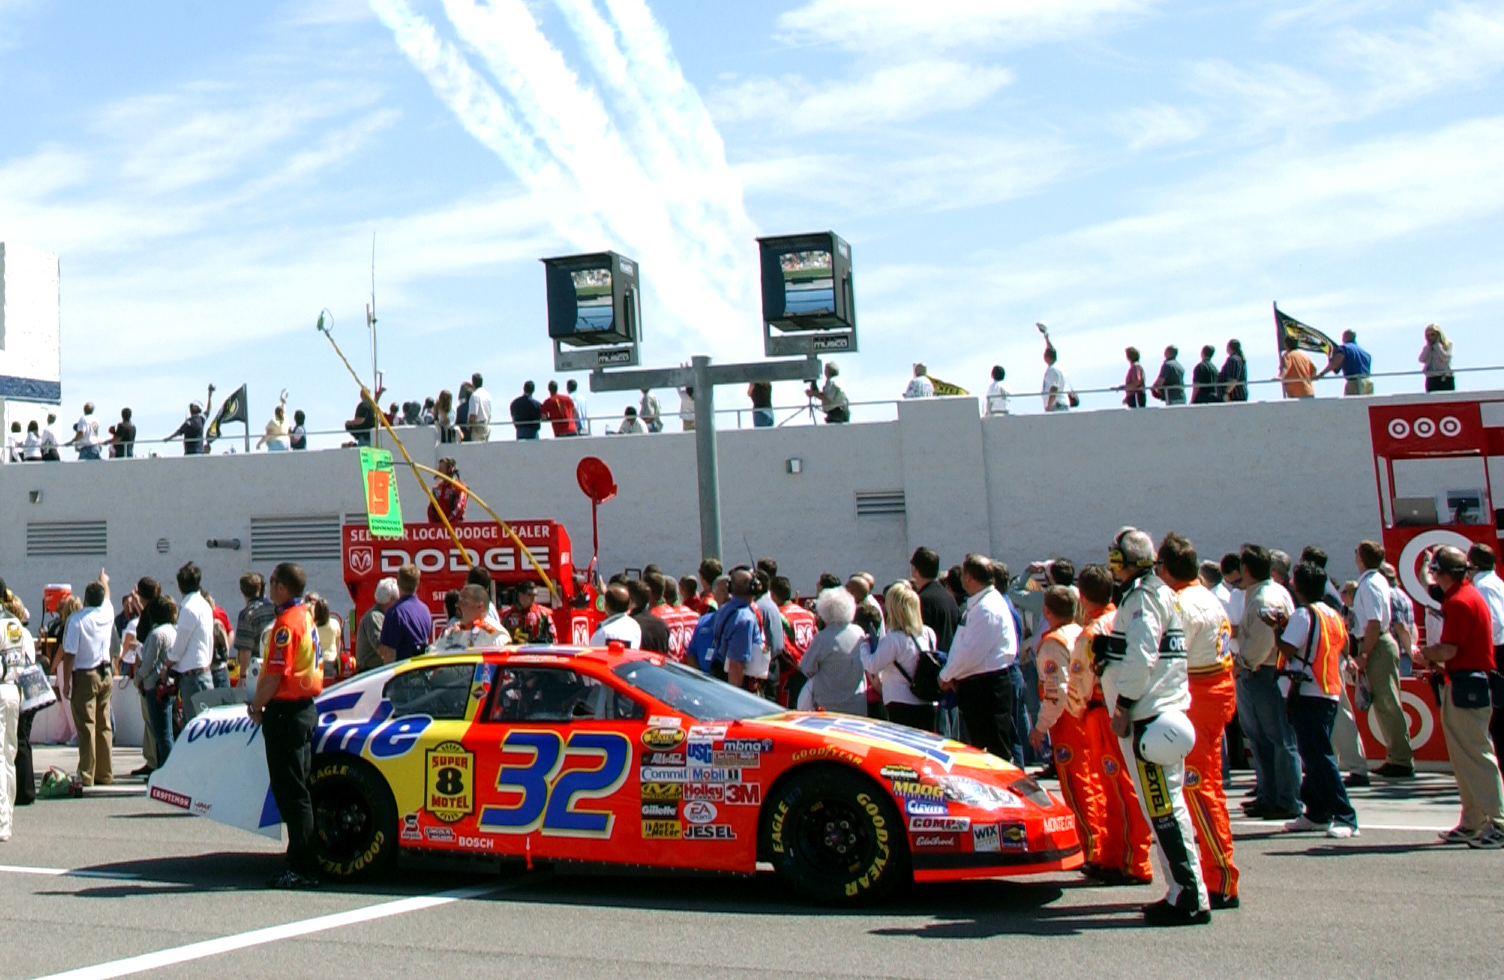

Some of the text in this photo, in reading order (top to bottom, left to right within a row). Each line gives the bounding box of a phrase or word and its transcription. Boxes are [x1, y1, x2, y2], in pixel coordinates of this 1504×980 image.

[413, 527, 450, 540] LOCAL
[455, 527, 497, 539] DODGE
[502, 525, 550, 538] DEALER
[380, 546, 550, 573] DODGE
[688, 743, 712, 764] USG
[723, 741, 761, 751] mbna
[432, 756, 468, 769] SUPER
[792, 744, 863, 766] GOODYEAR
[642, 768, 687, 779] Commit
[693, 769, 725, 780] Mobil
[436, 767, 464, 796] 8
[477, 728, 633, 839] 32
[893, 781, 945, 797] MOOG
[684, 783, 724, 798] Holley
[726, 784, 758, 803] 3M
[431, 793, 470, 809] MOTEL
[642, 804, 677, 816] Gillette
[684, 825, 735, 838] JESEL
[772, 800, 790, 853] EAGLE
[974, 824, 997, 839] WIX
[459, 836, 494, 849] BOSCH
[845, 792, 890, 897] GOODYEAR
